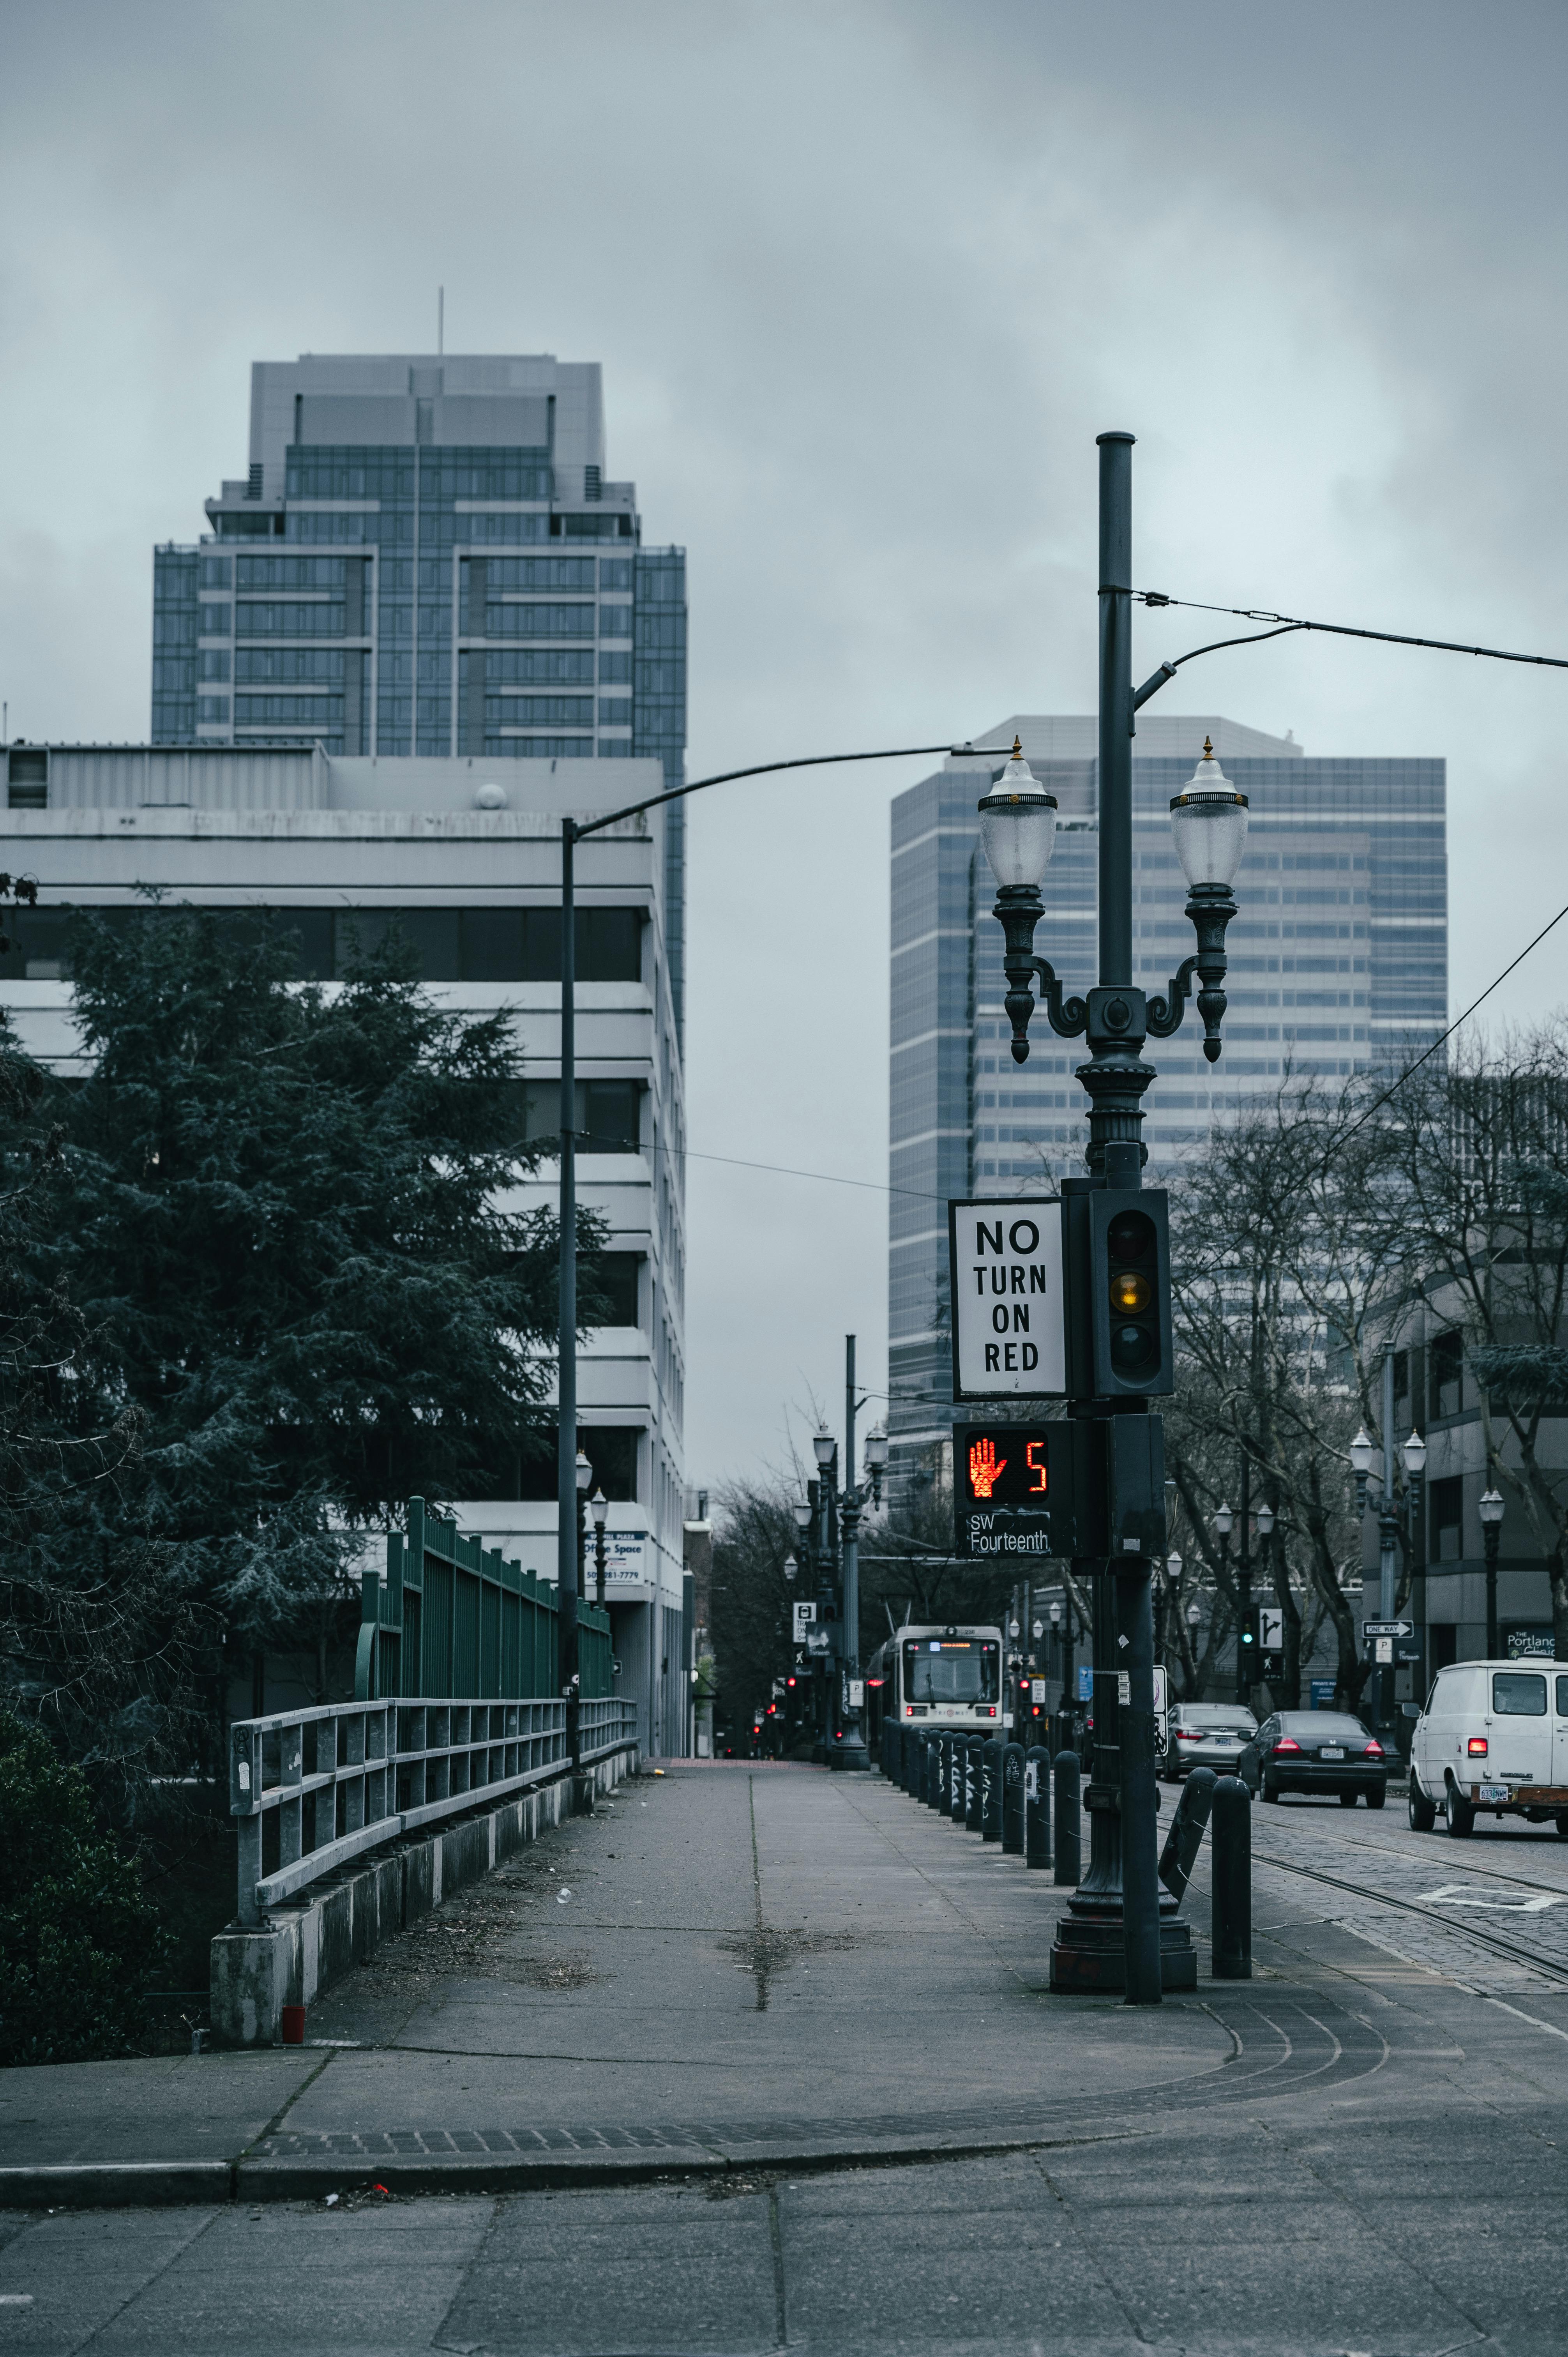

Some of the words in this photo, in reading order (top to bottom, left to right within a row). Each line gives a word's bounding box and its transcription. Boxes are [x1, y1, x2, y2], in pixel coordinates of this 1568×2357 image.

[976, 1219, 1040, 1255] NO
[973, 1265, 1046, 1295] TURN
[992, 1304, 1029, 1334] ON
[985, 1342, 1038, 1372] RED
[1027, 1442, 1047, 1491] 5
[971, 1515, 994, 1530] SW
[584, 1544, 611, 1553] Ofe
[614, 1544, 642, 1555] Space
[971, 1530, 1048, 1551] Fourteenth
